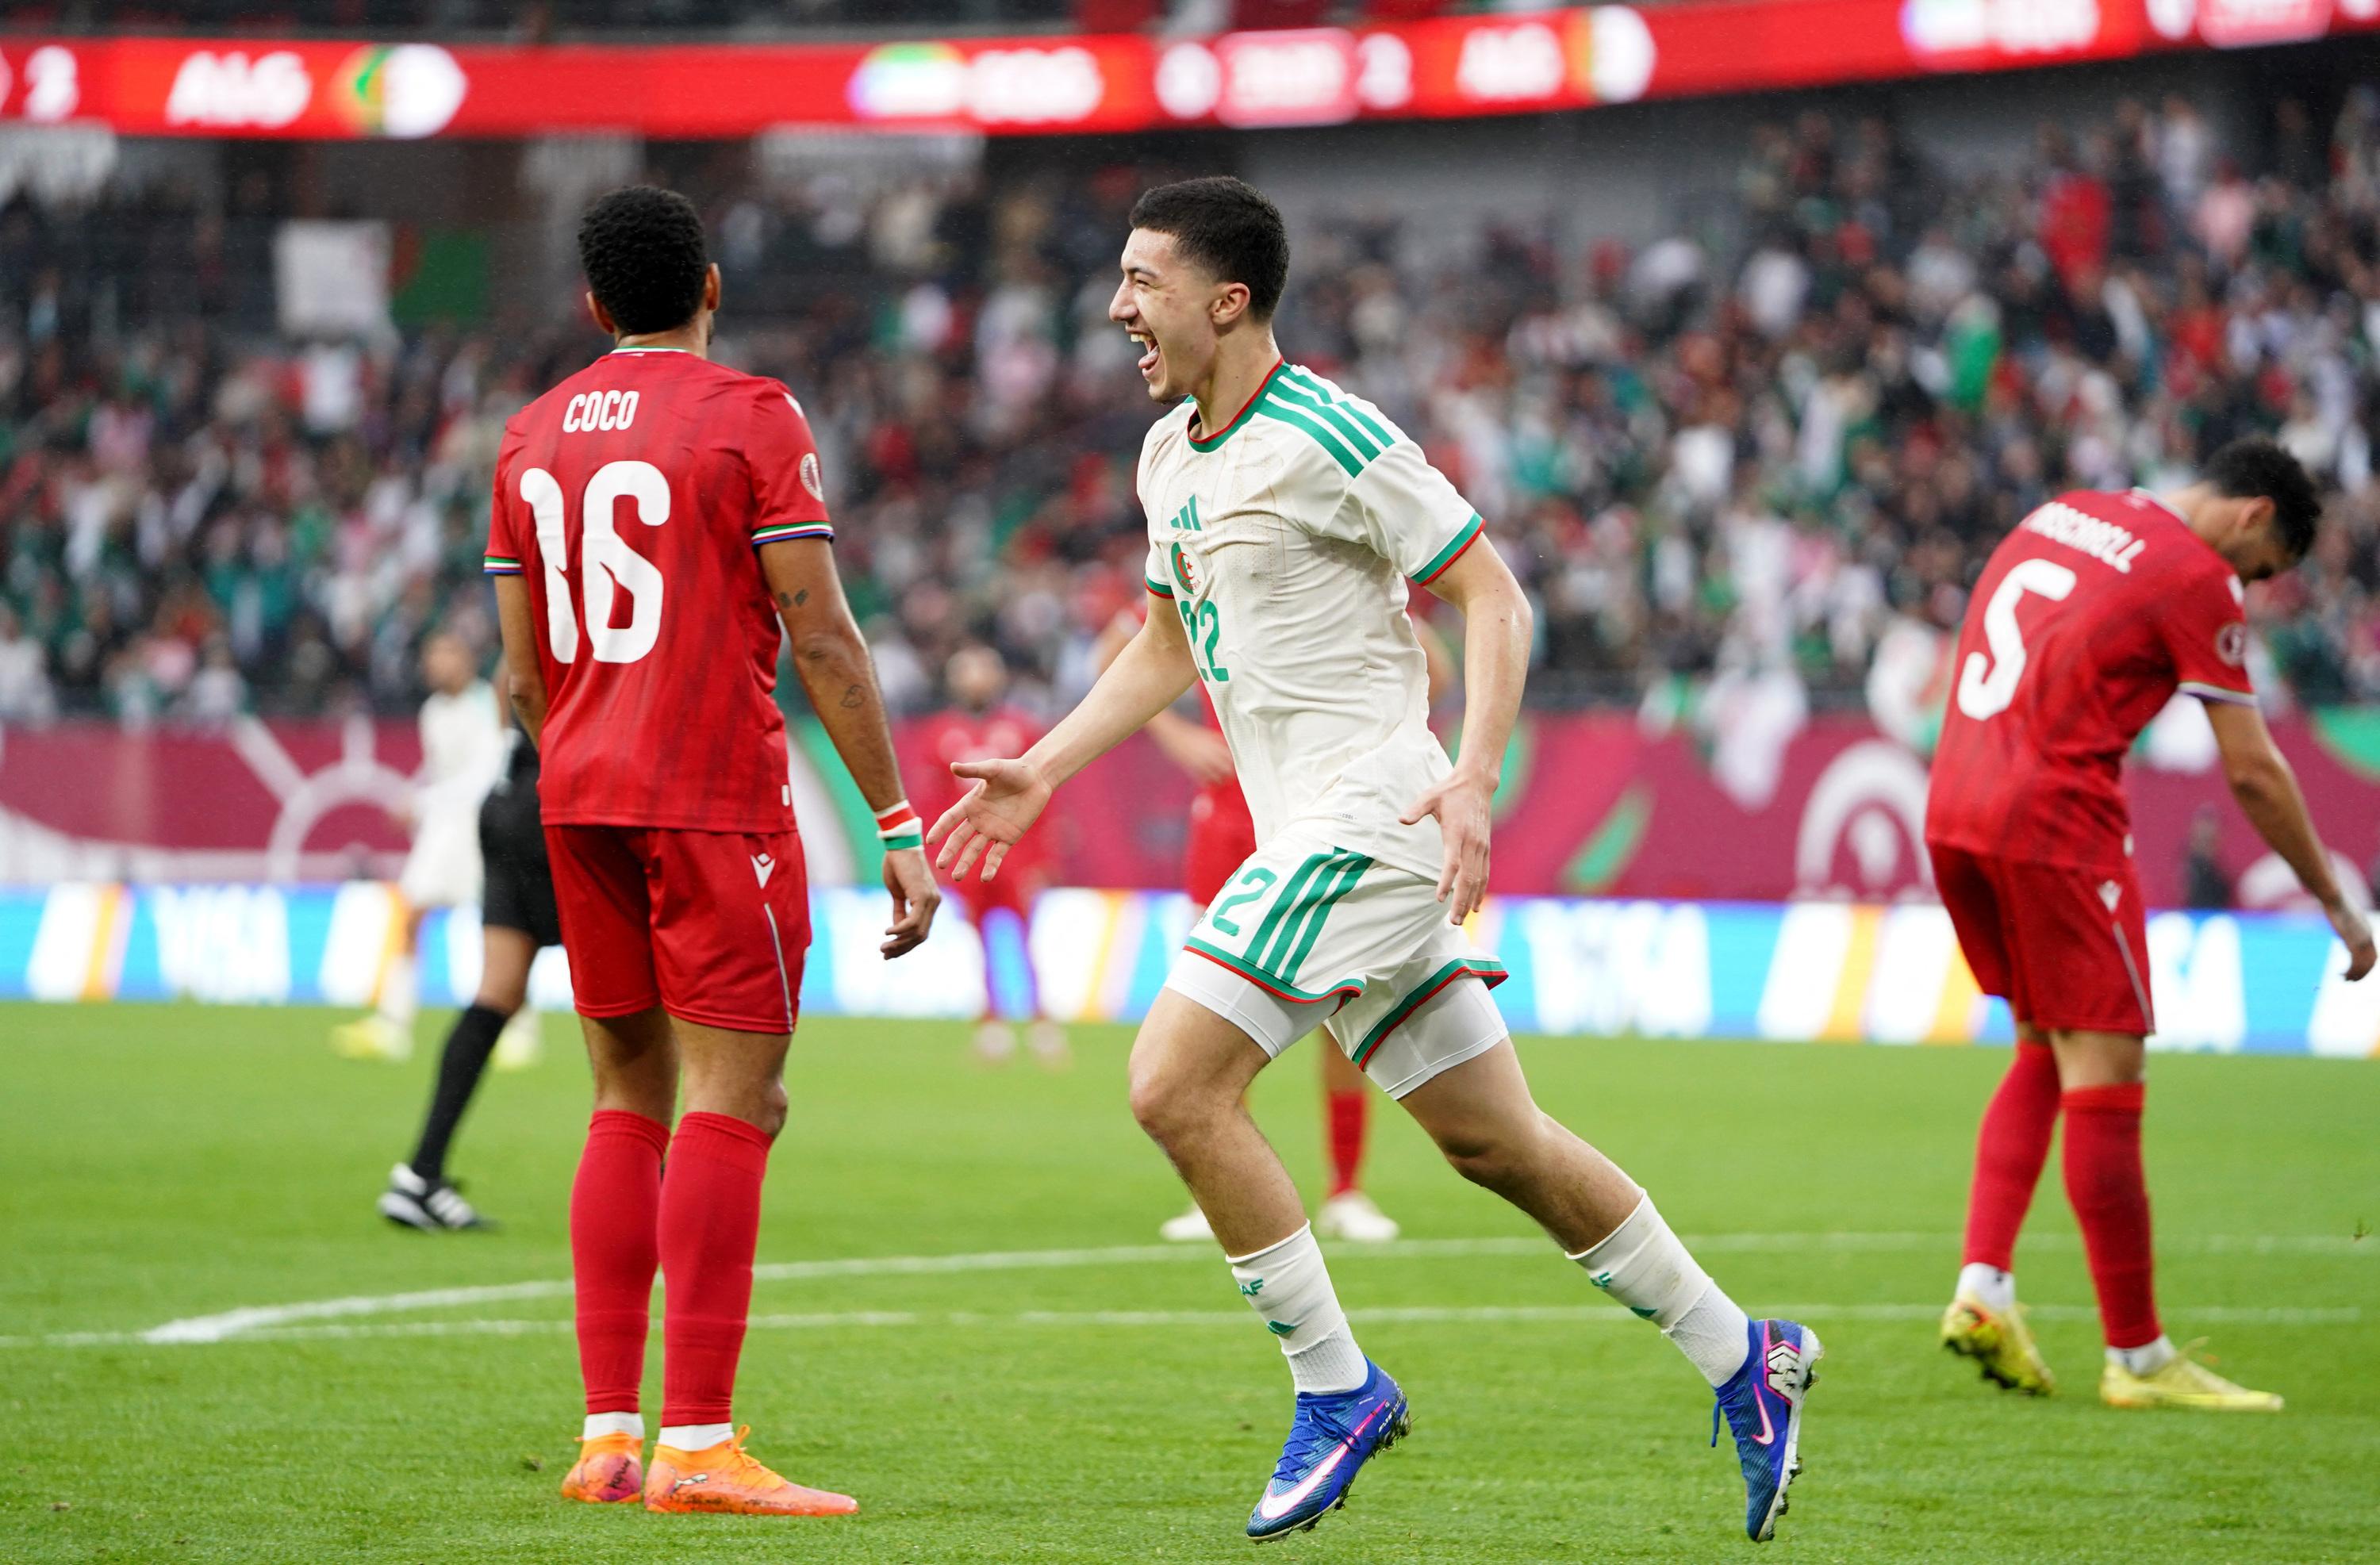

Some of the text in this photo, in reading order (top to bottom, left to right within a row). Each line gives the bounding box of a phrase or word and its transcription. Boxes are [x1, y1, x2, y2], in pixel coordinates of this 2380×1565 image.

[562, 390, 639, 433] COCO
[520, 460, 671, 664] 16
[1180, 600, 1229, 682] 22
[1957, 558, 2077, 721] 5
[1212, 865, 1277, 937] 2
[1241, 1278, 1264, 1295] AF
